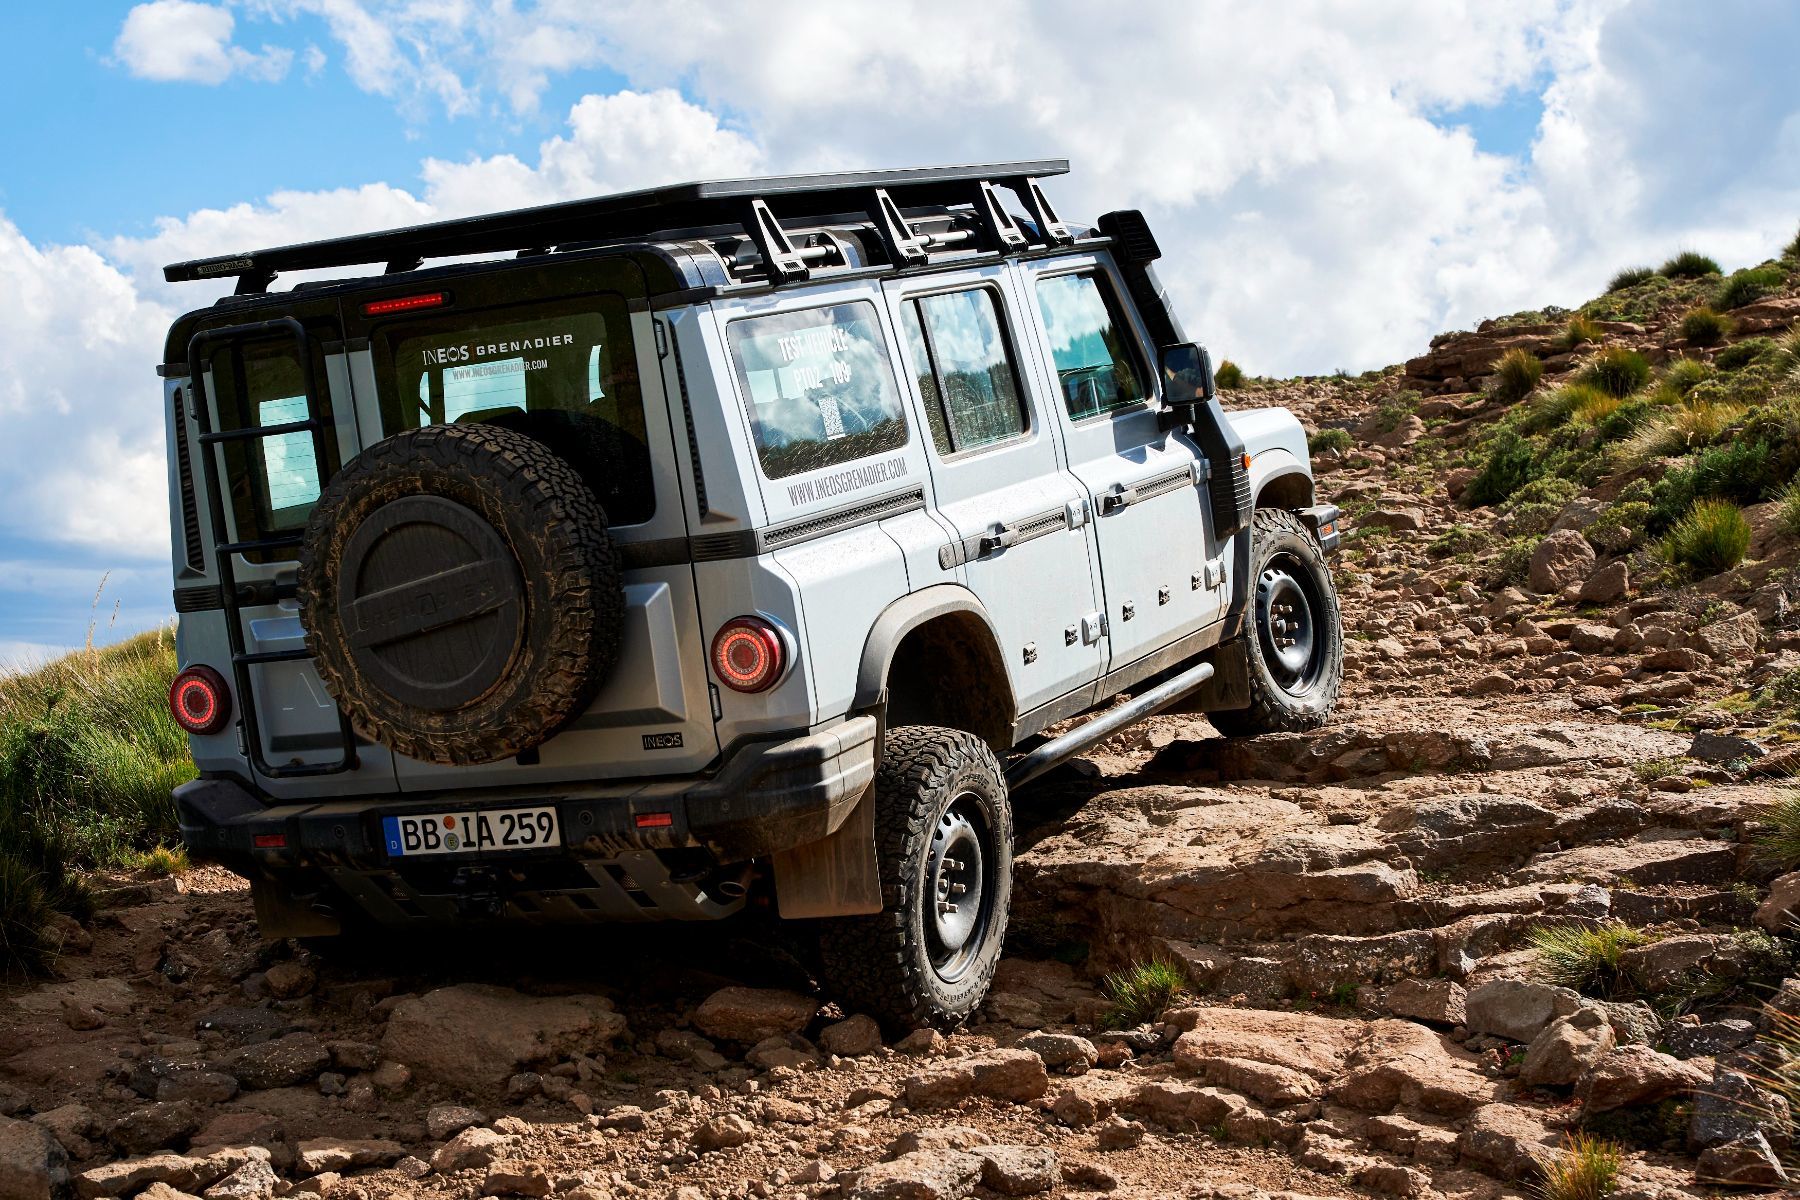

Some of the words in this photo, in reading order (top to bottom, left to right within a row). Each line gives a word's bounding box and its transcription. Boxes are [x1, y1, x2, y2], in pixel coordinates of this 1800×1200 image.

[422, 345, 469, 365] INEOS
[476, 334, 573, 356] GRENADIER
[778, 335, 802, 361] TEST
[805, 328, 848, 356] VEHICLE
[453, 359, 548, 380] WWW.INEOSGRENADIER.COM
[787, 457, 907, 506] WWW.INEOSGRENADIER.COM
[643, 734, 682, 748] INEOS
[391, 840, 398, 849] D
[402, 819, 441, 850] BB
[461, 816, 495, 848] IA
[500, 812, 554, 846] 259
